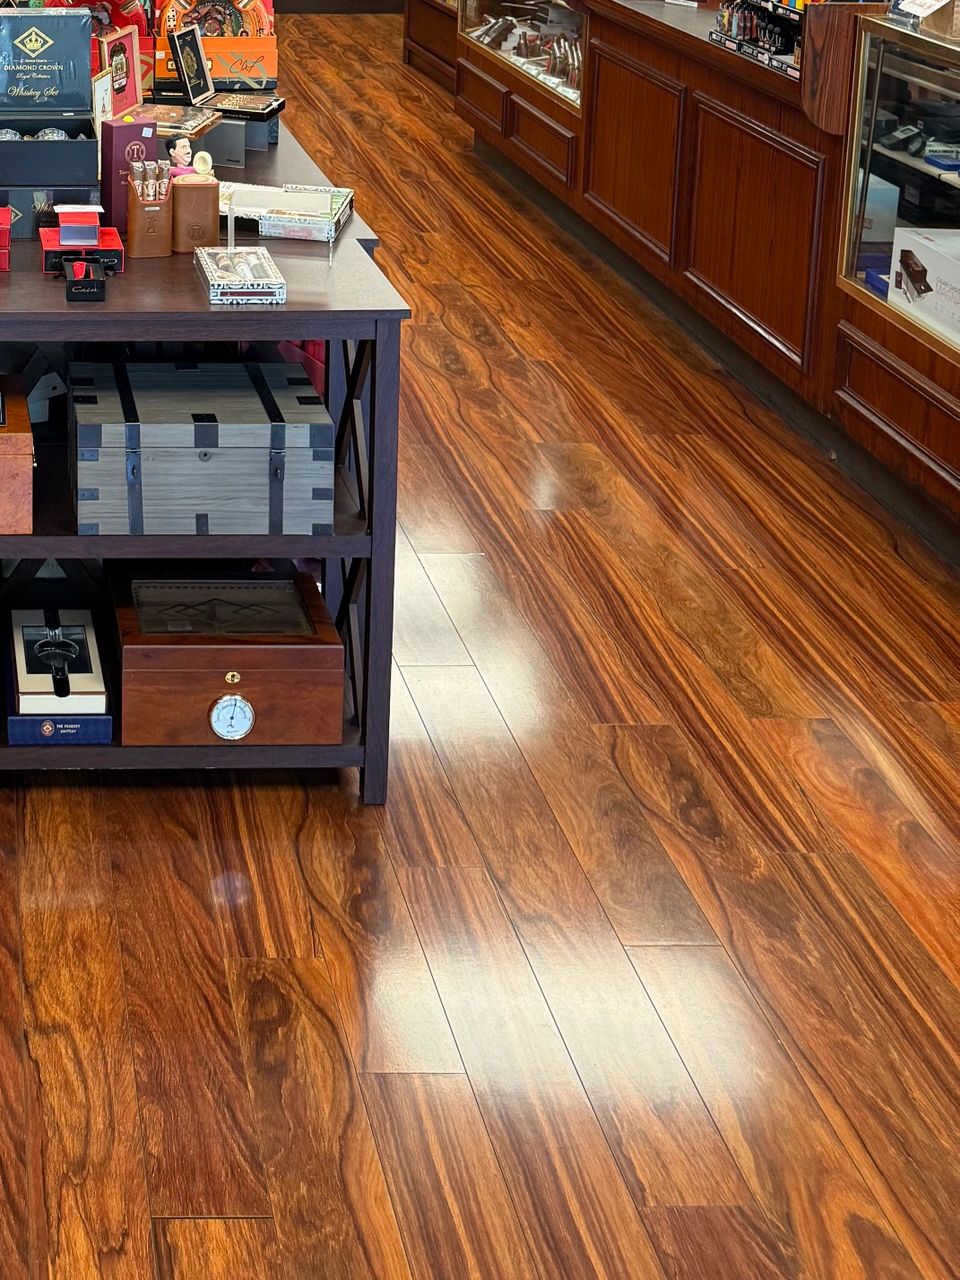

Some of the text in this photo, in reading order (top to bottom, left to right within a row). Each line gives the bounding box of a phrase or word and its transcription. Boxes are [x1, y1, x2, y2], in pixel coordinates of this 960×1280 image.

[7, 84, 59, 99] Whiskey Set
[72, 285, 99, 294] Cain
